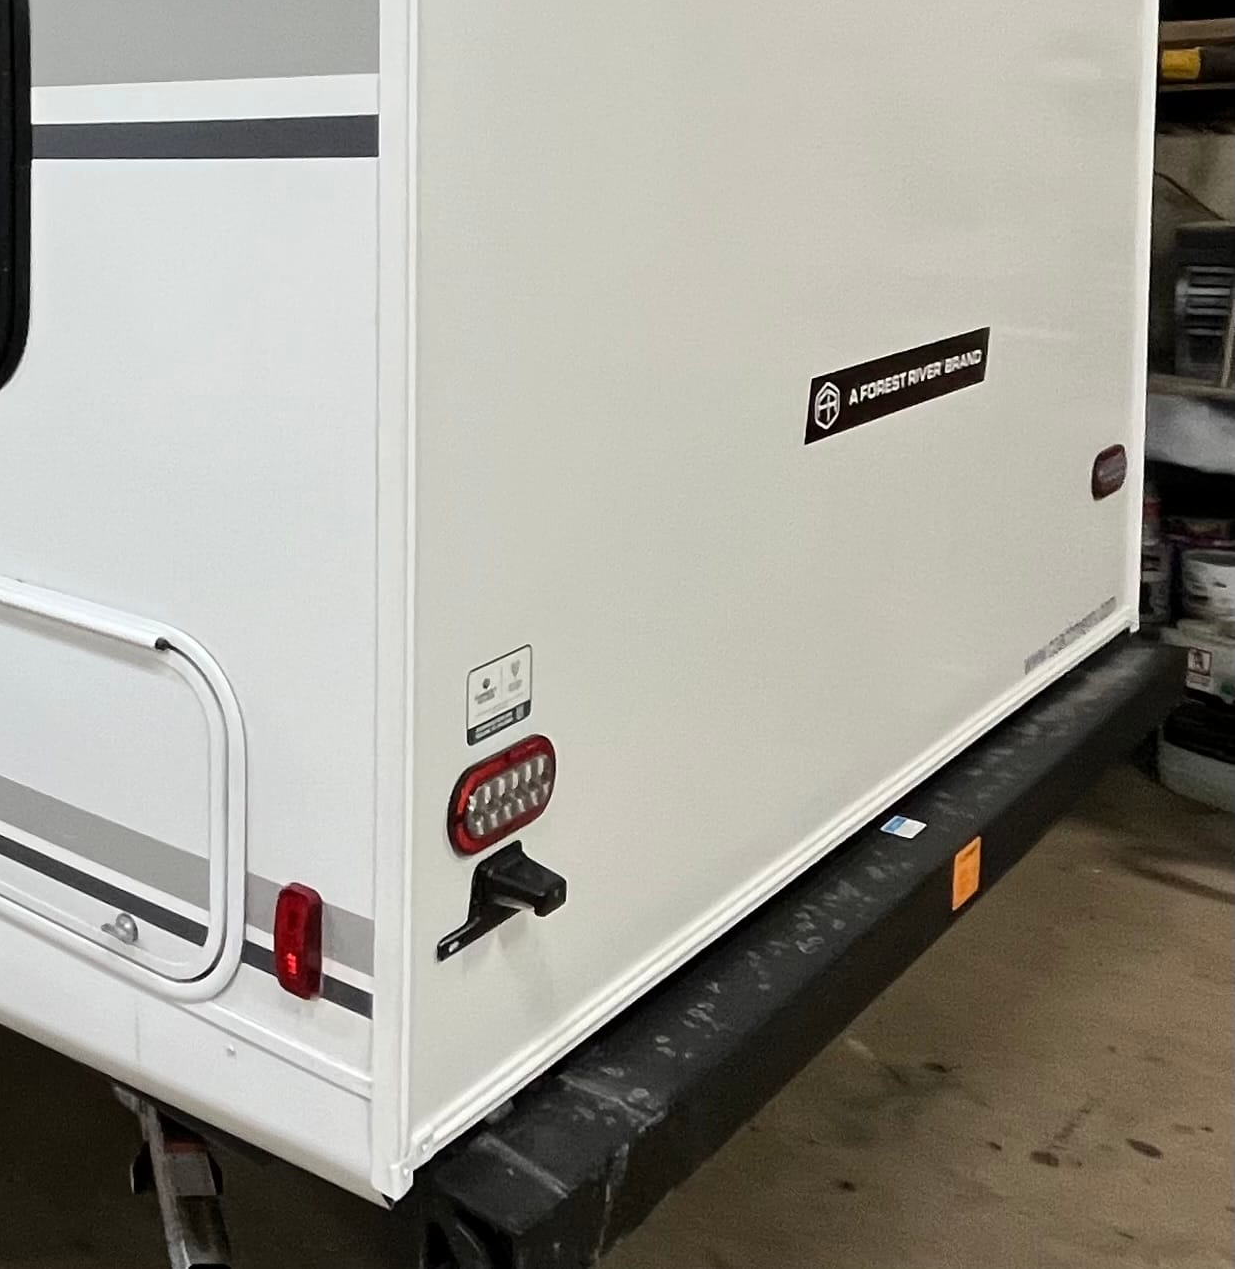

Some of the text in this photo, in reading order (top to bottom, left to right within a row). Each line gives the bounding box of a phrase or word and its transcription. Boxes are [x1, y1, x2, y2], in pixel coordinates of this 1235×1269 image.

[849, 349, 983, 406] A FOREST RIVER BRAND
